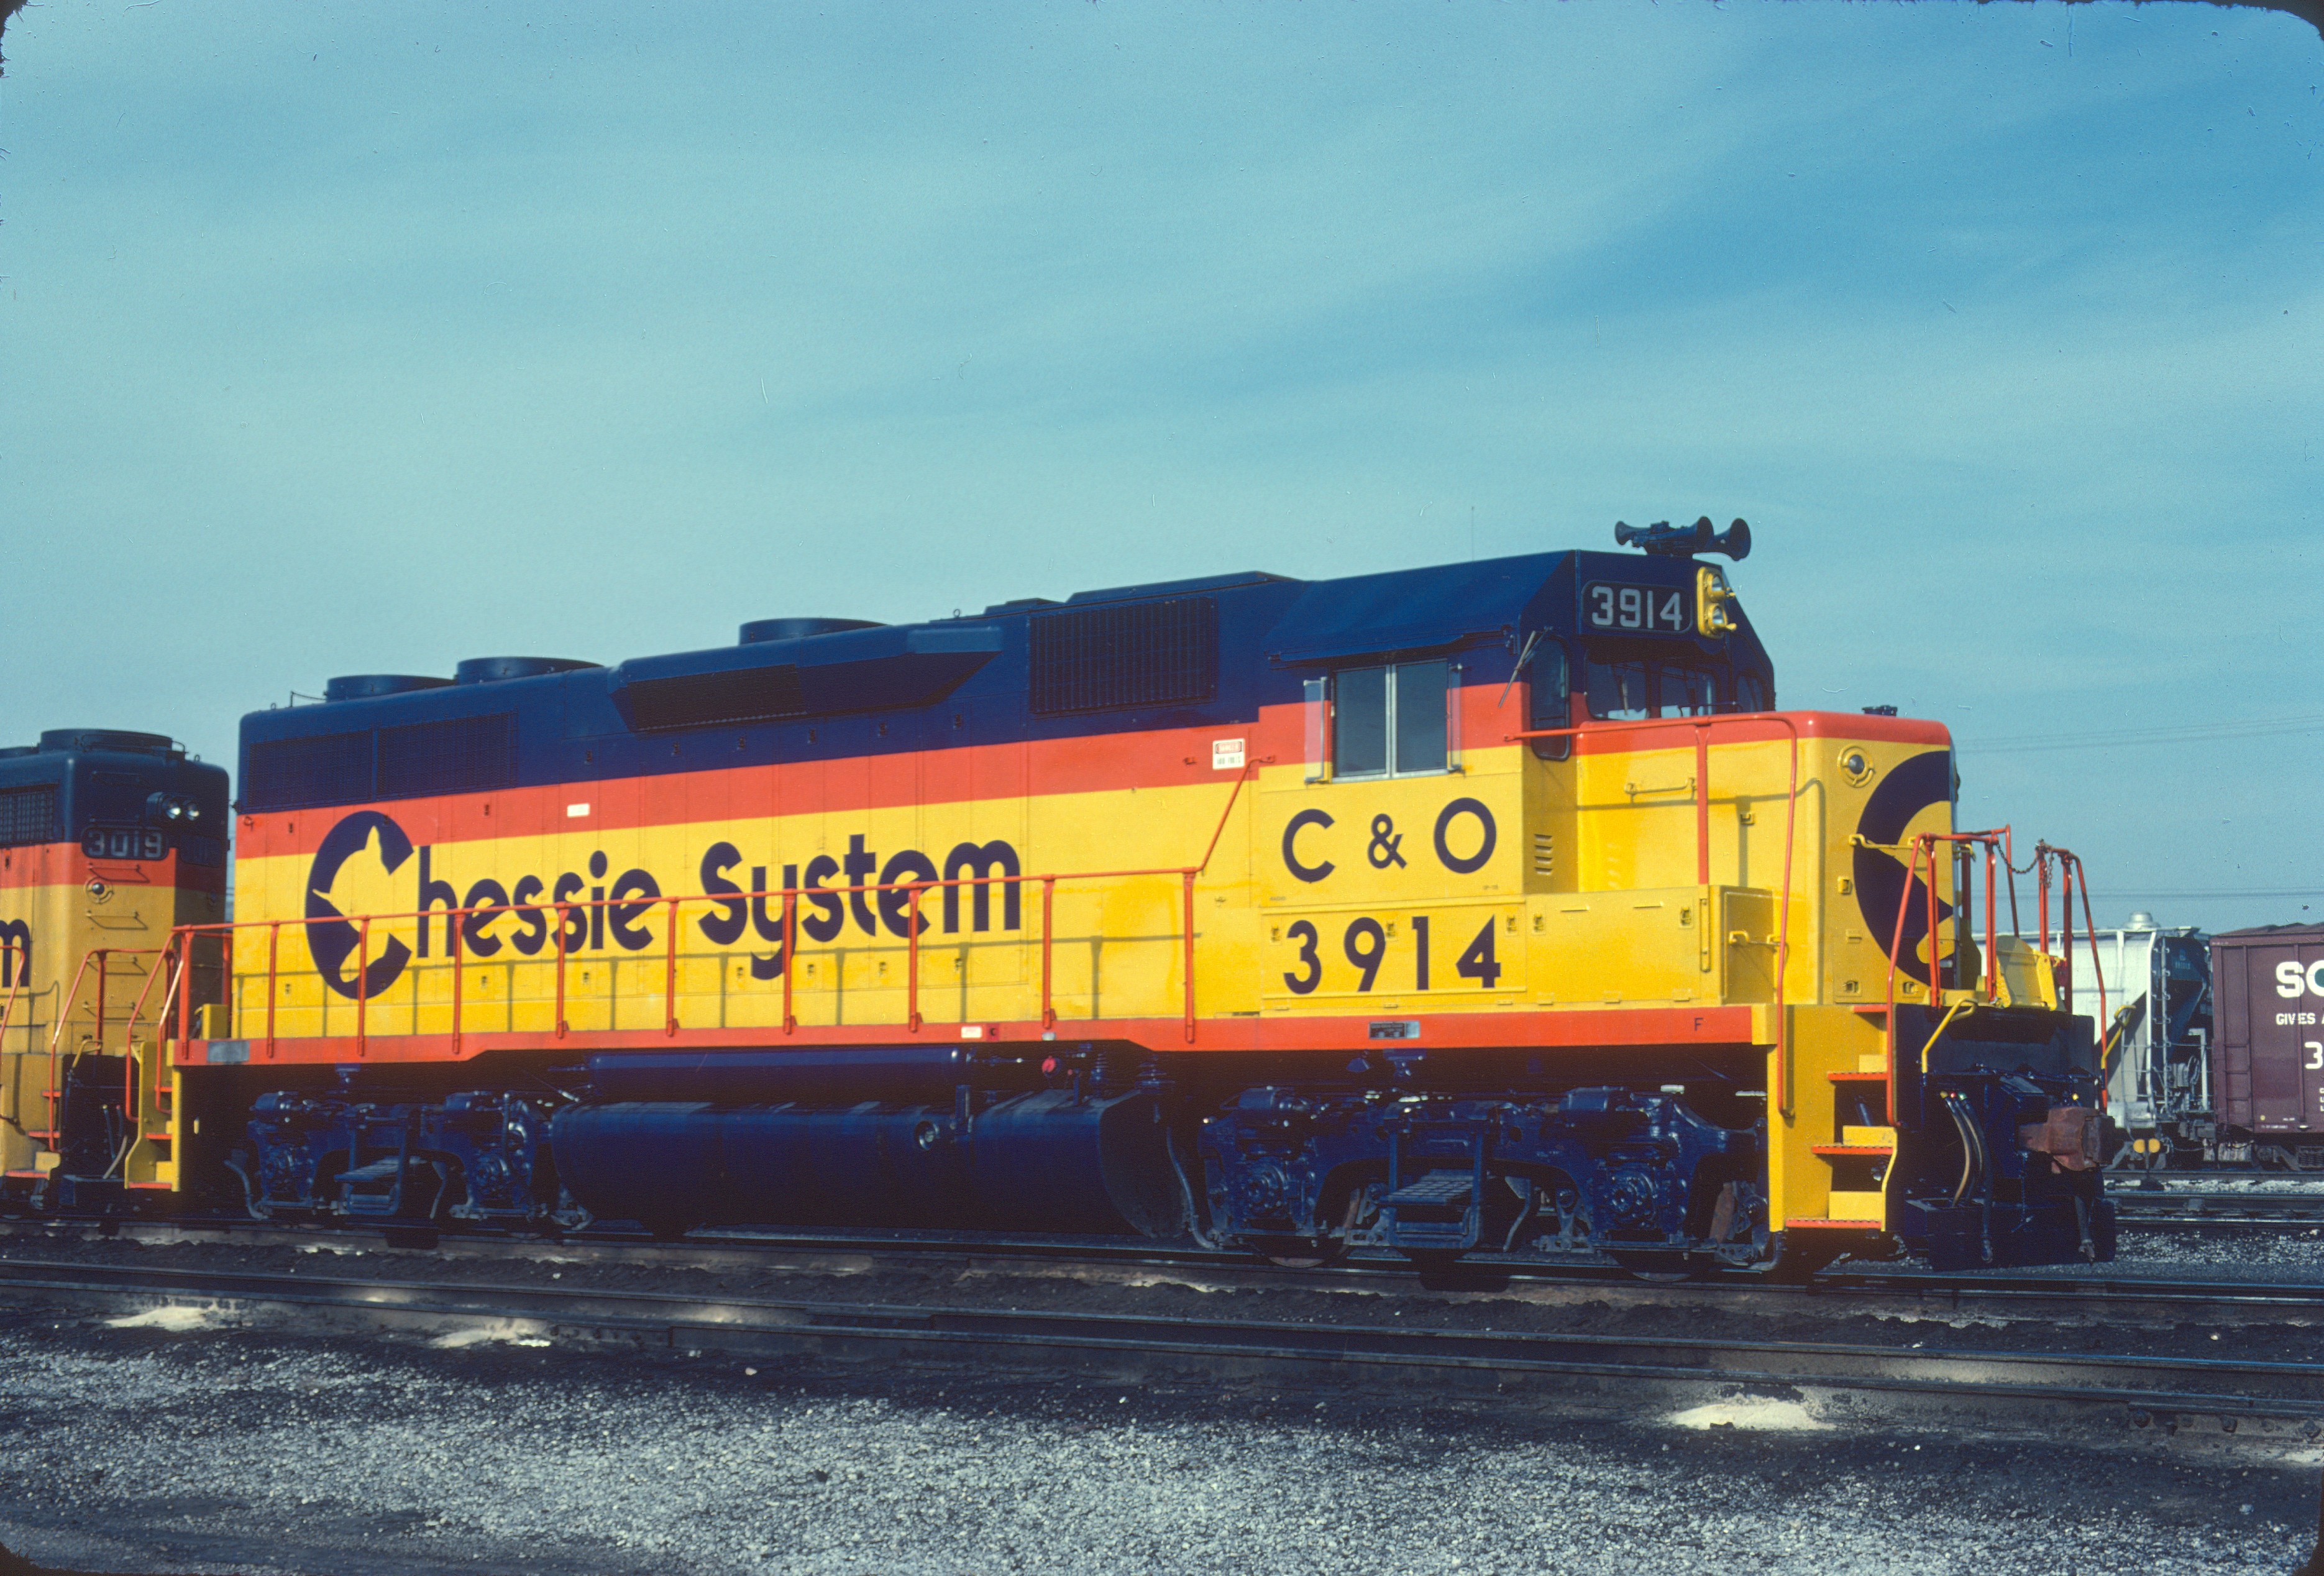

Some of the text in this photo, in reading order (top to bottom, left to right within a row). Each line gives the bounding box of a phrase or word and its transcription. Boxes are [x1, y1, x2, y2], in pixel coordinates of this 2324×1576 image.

[1592, 586, 1682, 631] 3914
[88, 830, 162, 858] 3019
[1283, 797, 1496, 882] C & O
[305, 810, 1020, 1000] Chessie System
[1284, 915, 1501, 994] 3914
[1695, 1017, 1703, 1032] F
[2276, 1012, 2316, 1025] GIVES
[2304, 1041, 2323, 1070] 3
